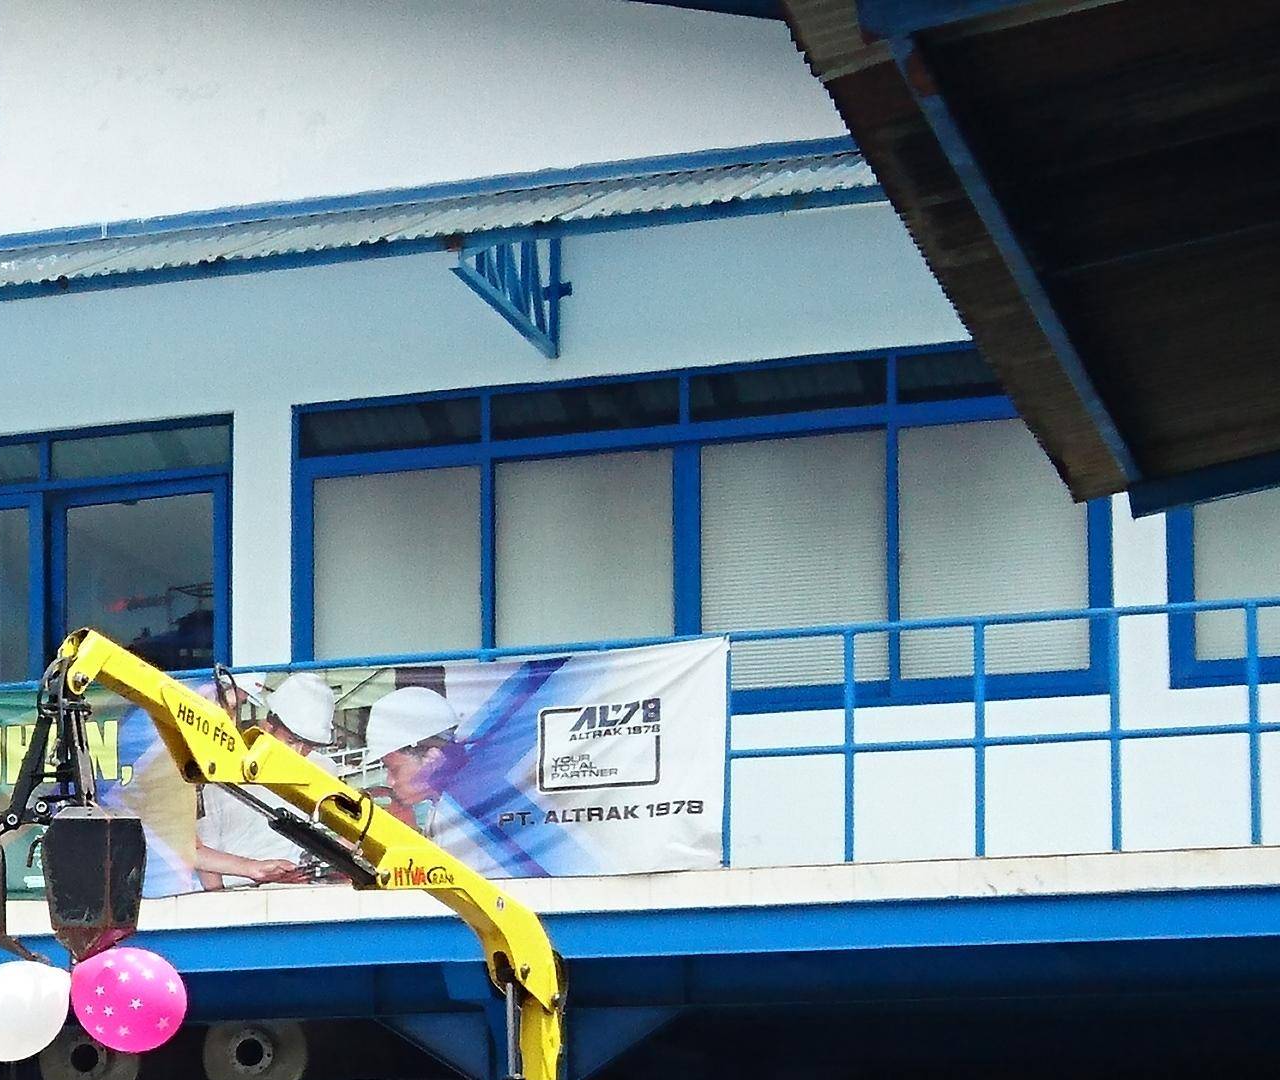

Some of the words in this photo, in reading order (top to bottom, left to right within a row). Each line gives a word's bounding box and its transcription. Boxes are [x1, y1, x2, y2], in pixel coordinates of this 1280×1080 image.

[177, 703, 209, 735] HB10
[213, 727, 235, 752] FFB
[569, 727, 622, 742] ALTRAK
[552, 753, 590, 765] YOUR
[551, 767, 618, 780] PARTNER
[552, 761, 597, 773] TOTAL
[498, 810, 536, 828] PT.
[544, 804, 640, 825] ALTRAK
[646, 799, 705, 819] 1978
